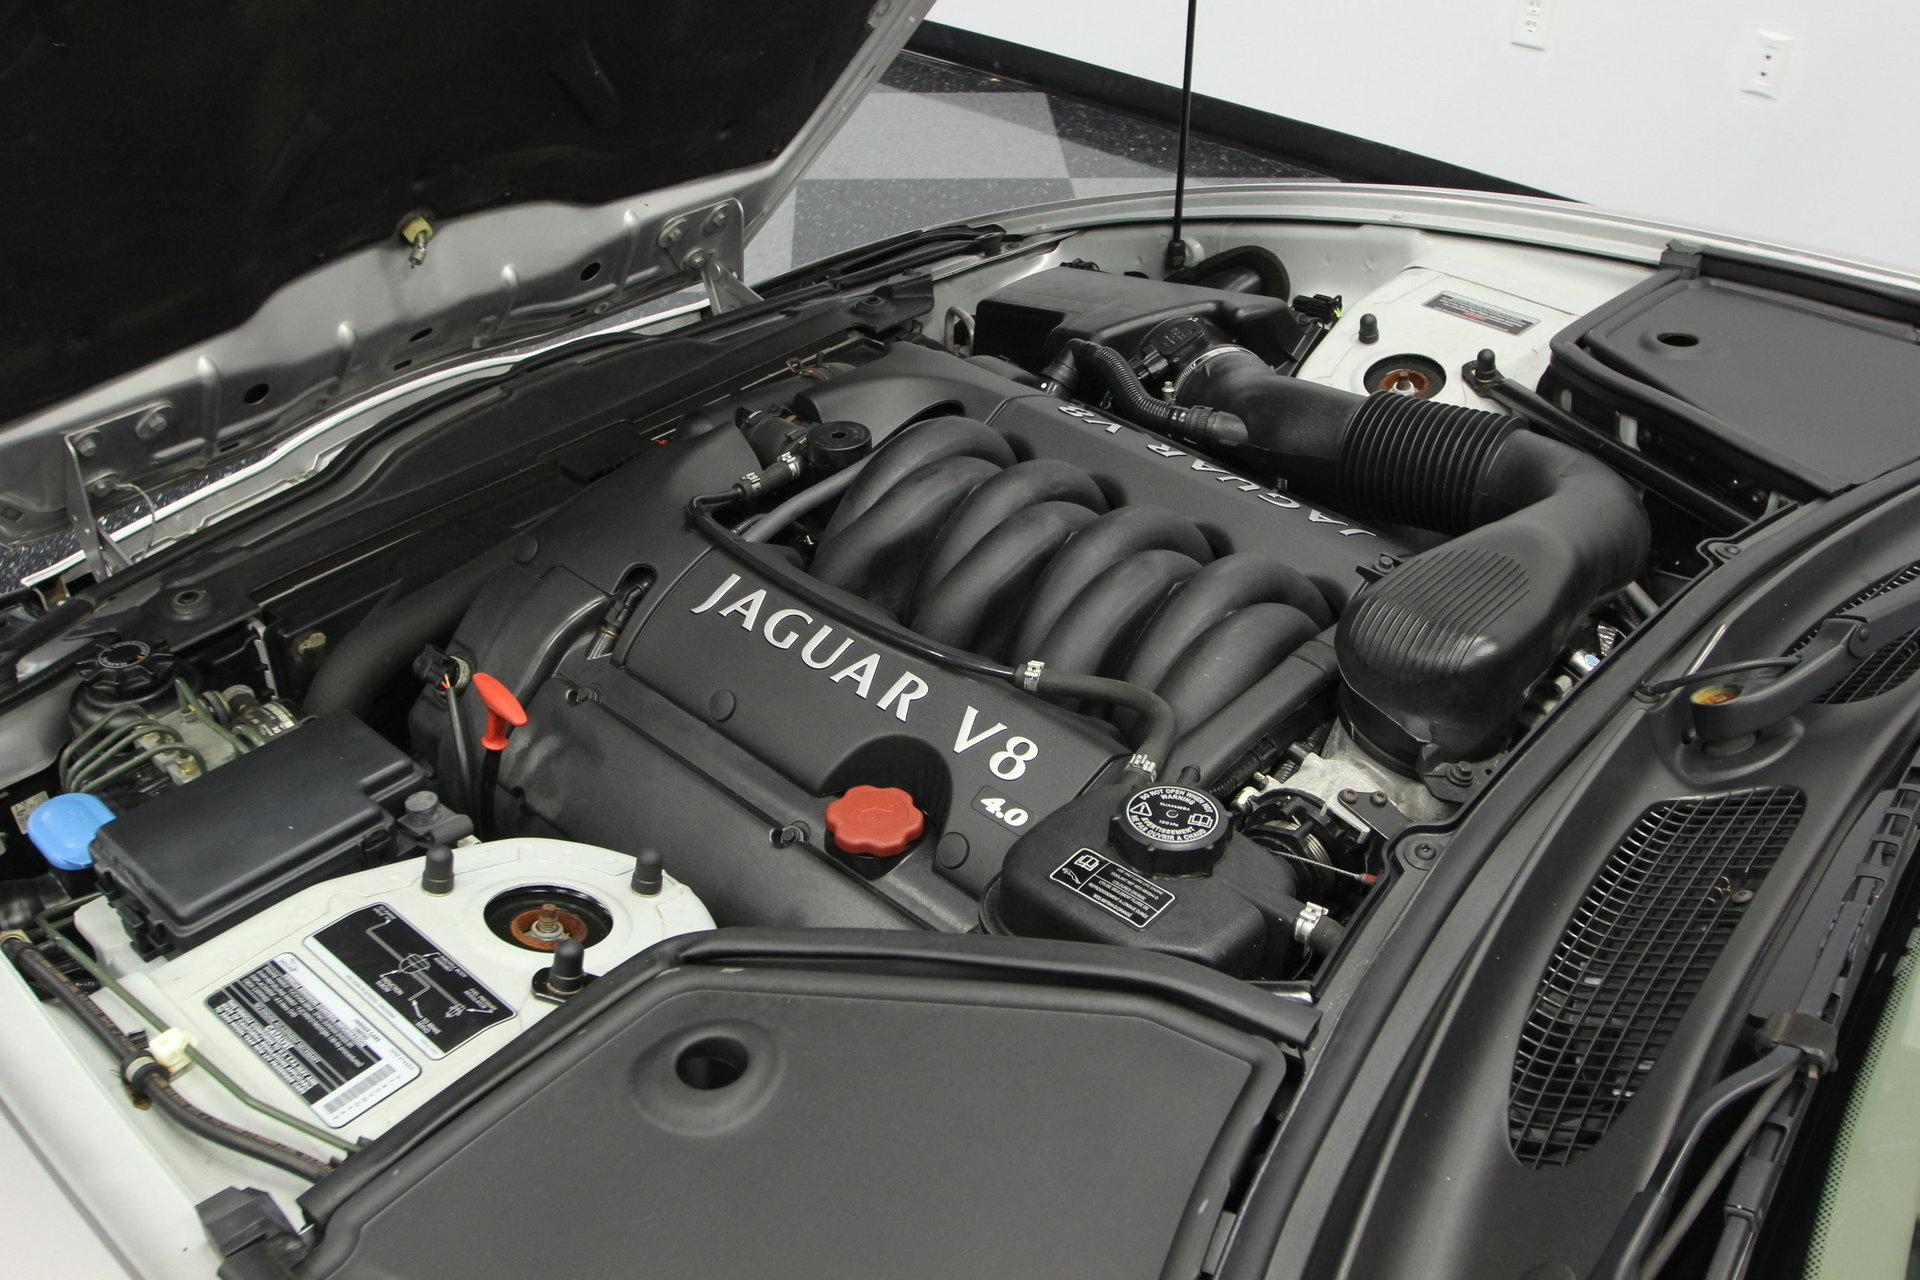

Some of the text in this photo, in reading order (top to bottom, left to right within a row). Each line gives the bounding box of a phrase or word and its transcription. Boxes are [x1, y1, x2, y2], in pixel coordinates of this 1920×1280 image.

[690, 572, 1039, 781] JAGUAR V8
[980, 796, 1030, 827] 4.0
[1149, 789, 1164, 798] NOT
[1165, 788, 1186, 796] OPEN
[1186, 791, 1206, 804] WHEN
[1201, 800, 1214, 814] HOT
[1160, 794, 1196, 805] WARNING
[1130, 815, 1138, 823] NE
[1135, 821, 1148, 832] PAS
[1148, 829, 1175, 841] OUVRIR
[1183, 828, 1207, 840] CHAUD
[1140, 817, 1195, 836] AVERTISSEMENT
